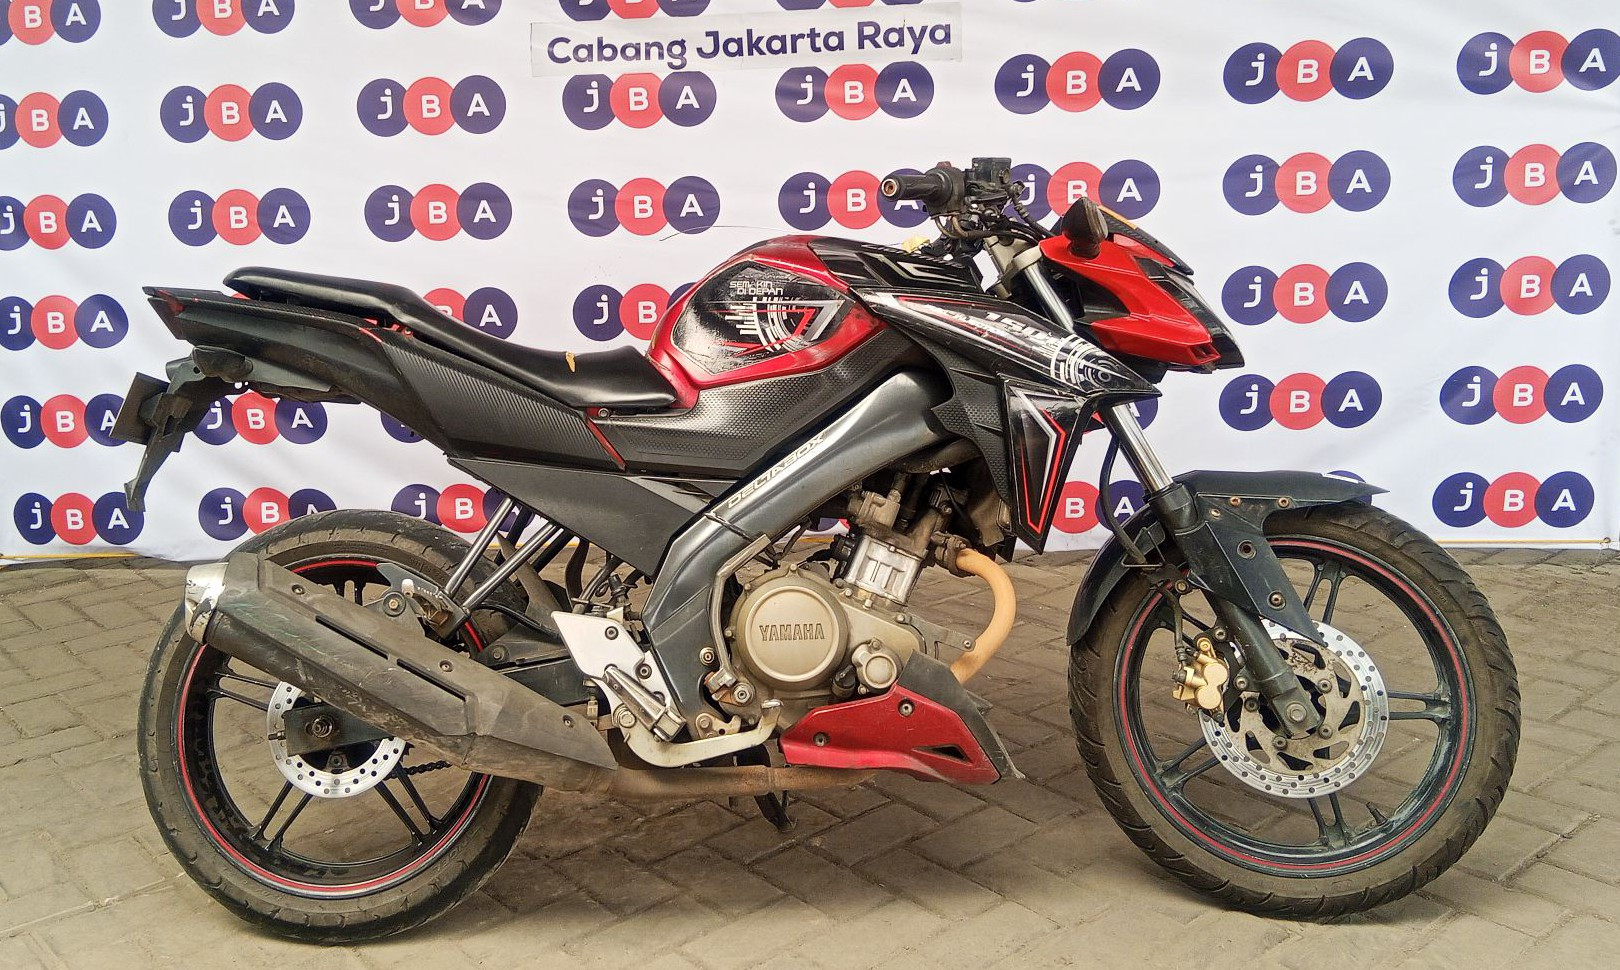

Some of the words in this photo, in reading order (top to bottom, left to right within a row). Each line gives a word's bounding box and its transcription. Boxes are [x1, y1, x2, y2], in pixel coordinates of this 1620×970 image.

[24, 3, 88, 28] BA
[547, 36, 687, 70] Cabang
[696, 28, 844, 59] Jakarta
[857, 21, 952, 55] Raya
[759, 623, 825, 641] YAMAHA
